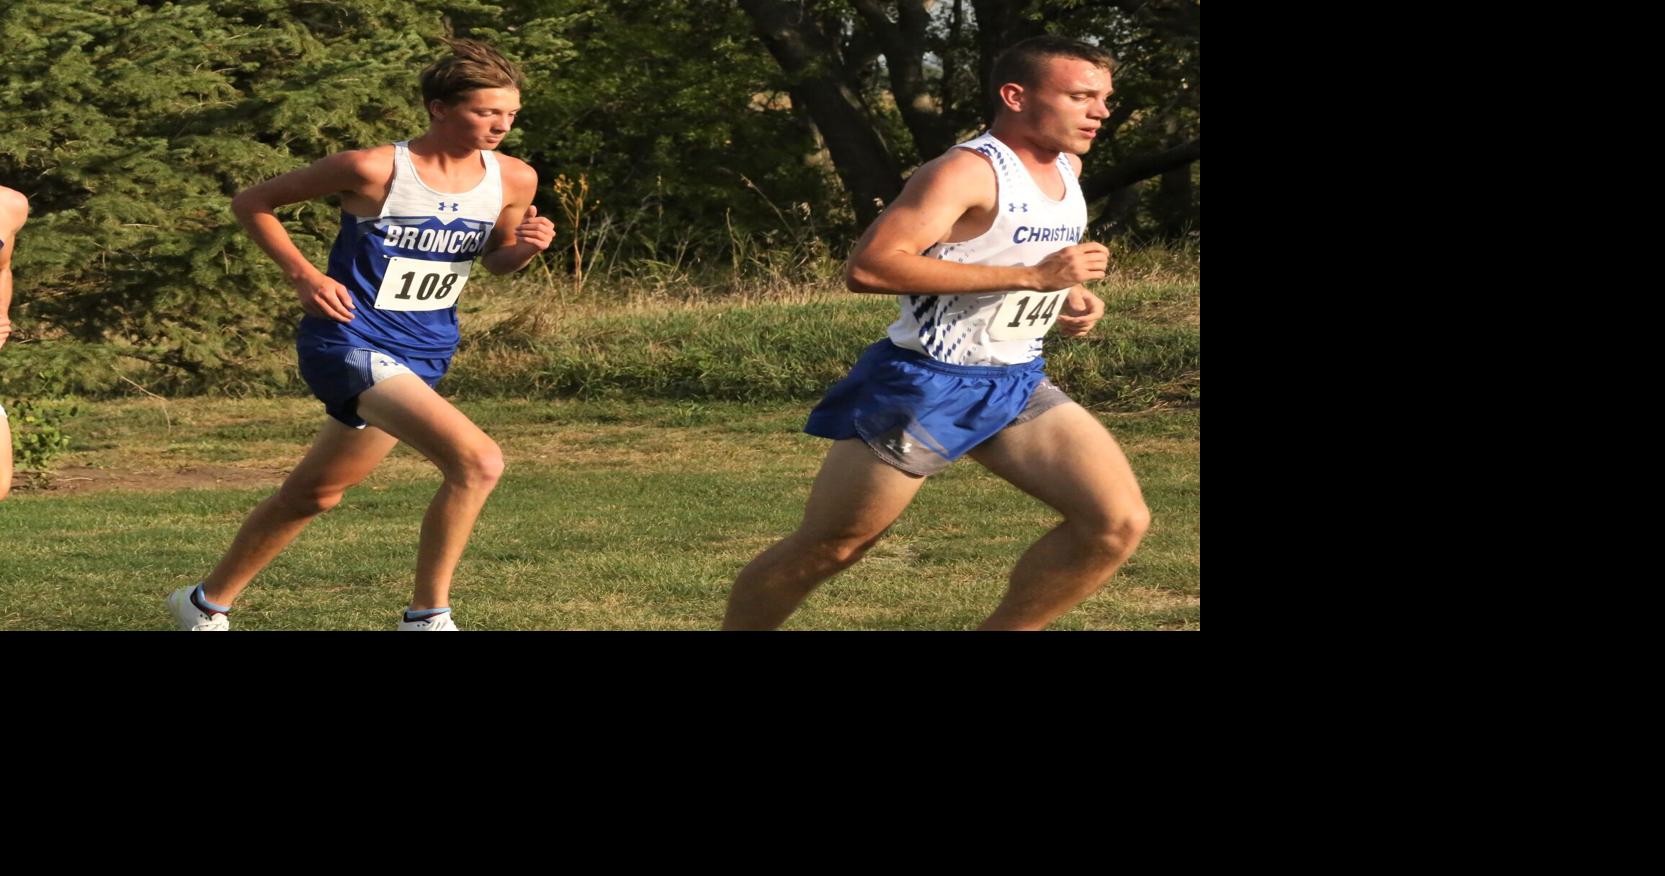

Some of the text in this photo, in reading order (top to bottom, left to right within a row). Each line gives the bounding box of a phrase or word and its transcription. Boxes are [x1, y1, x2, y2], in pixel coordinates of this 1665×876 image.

[383, 225, 483, 254] BRONCOS
[1013, 225, 1081, 244] CHRISTIAN
[394, 271, 458, 300] 108
[1007, 294, 1060, 328] 144
